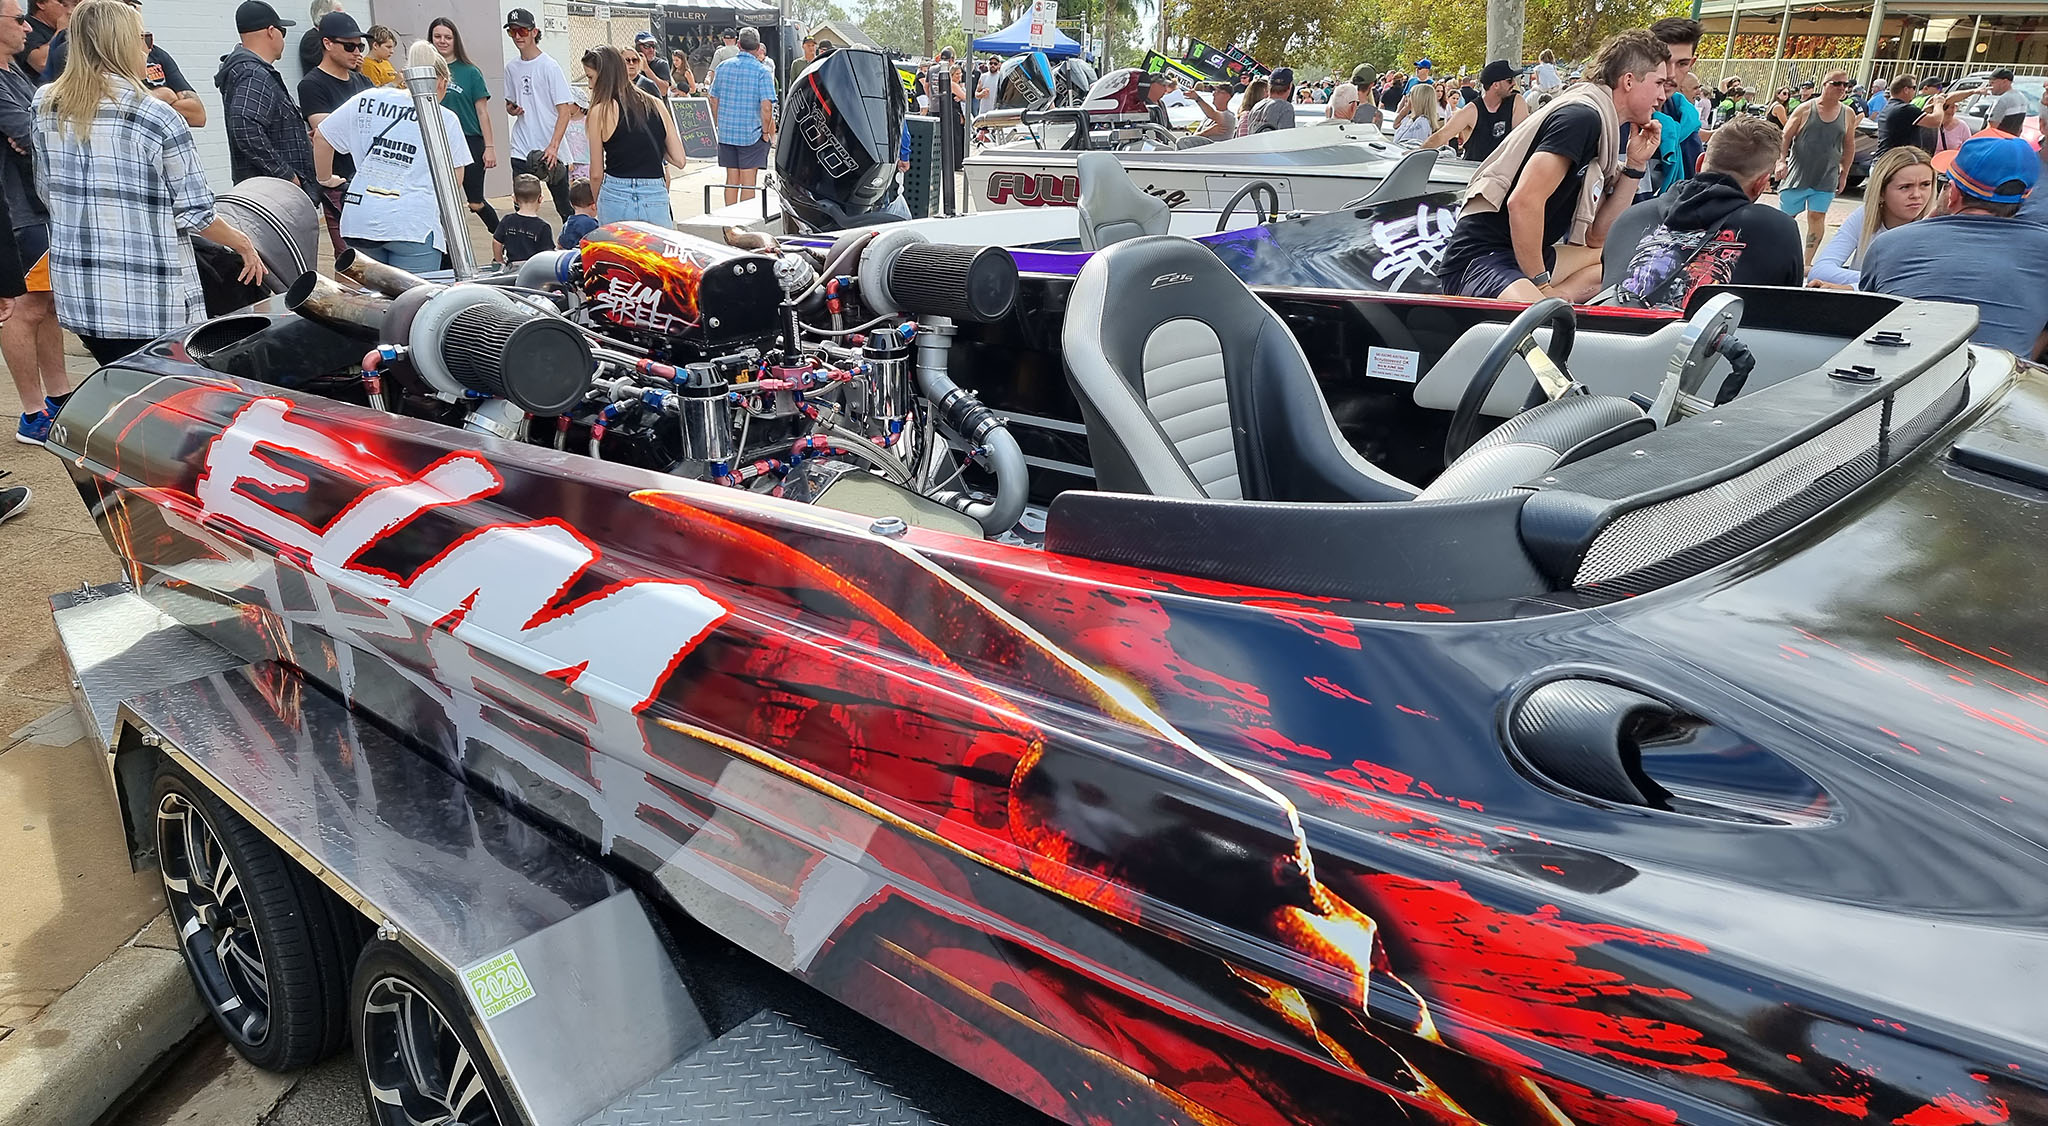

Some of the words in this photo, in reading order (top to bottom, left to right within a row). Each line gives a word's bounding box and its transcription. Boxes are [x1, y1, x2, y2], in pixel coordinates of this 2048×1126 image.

[1046, 2, 1057, 10] 2P
[1008, 69, 1041, 104] 300
[358, 97, 376, 114] PE
[376, 101, 419, 122] NATIO
[789, 88, 852, 179] 300
[382, 150, 414, 165] SPORT
[987, 171, 1080, 207] FULL
[609, 277, 663, 310] ELM
[588, 291, 700, 335] STREET
[198, 397, 732, 712] ELM
[466, 957, 504, 981] SOUTHERN
[475, 964, 525, 1005] 2020
[484, 987, 533, 1017] COMPETITOR
